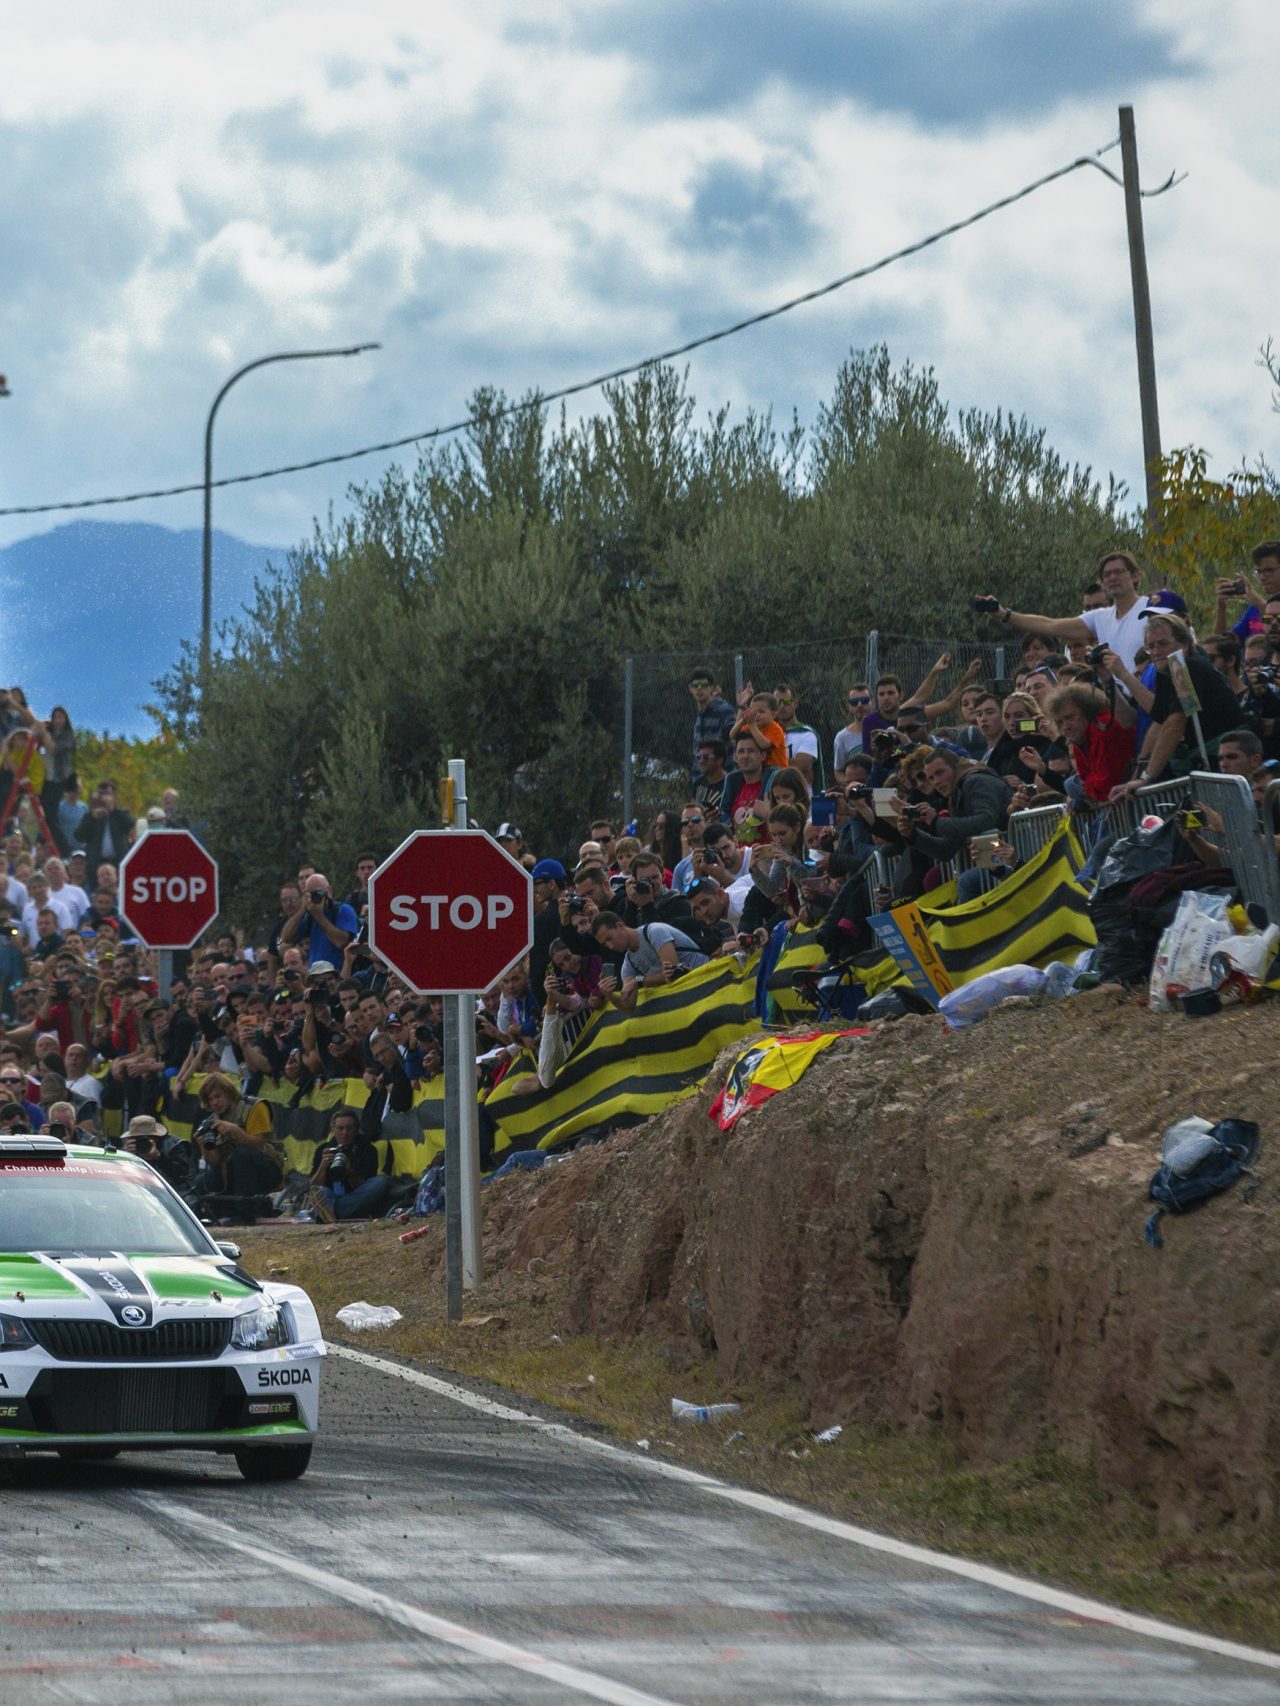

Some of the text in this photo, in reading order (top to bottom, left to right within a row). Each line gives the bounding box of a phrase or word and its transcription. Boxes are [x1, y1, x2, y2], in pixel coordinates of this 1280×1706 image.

[132, 876, 208, 903] STOP
[389, 895, 515, 931] STOP
[4, 1164, 87, 1174] Championship
[257, 1367, 312, 1387] ŠKODA
[269, 1403, 292, 1413] EDGE
